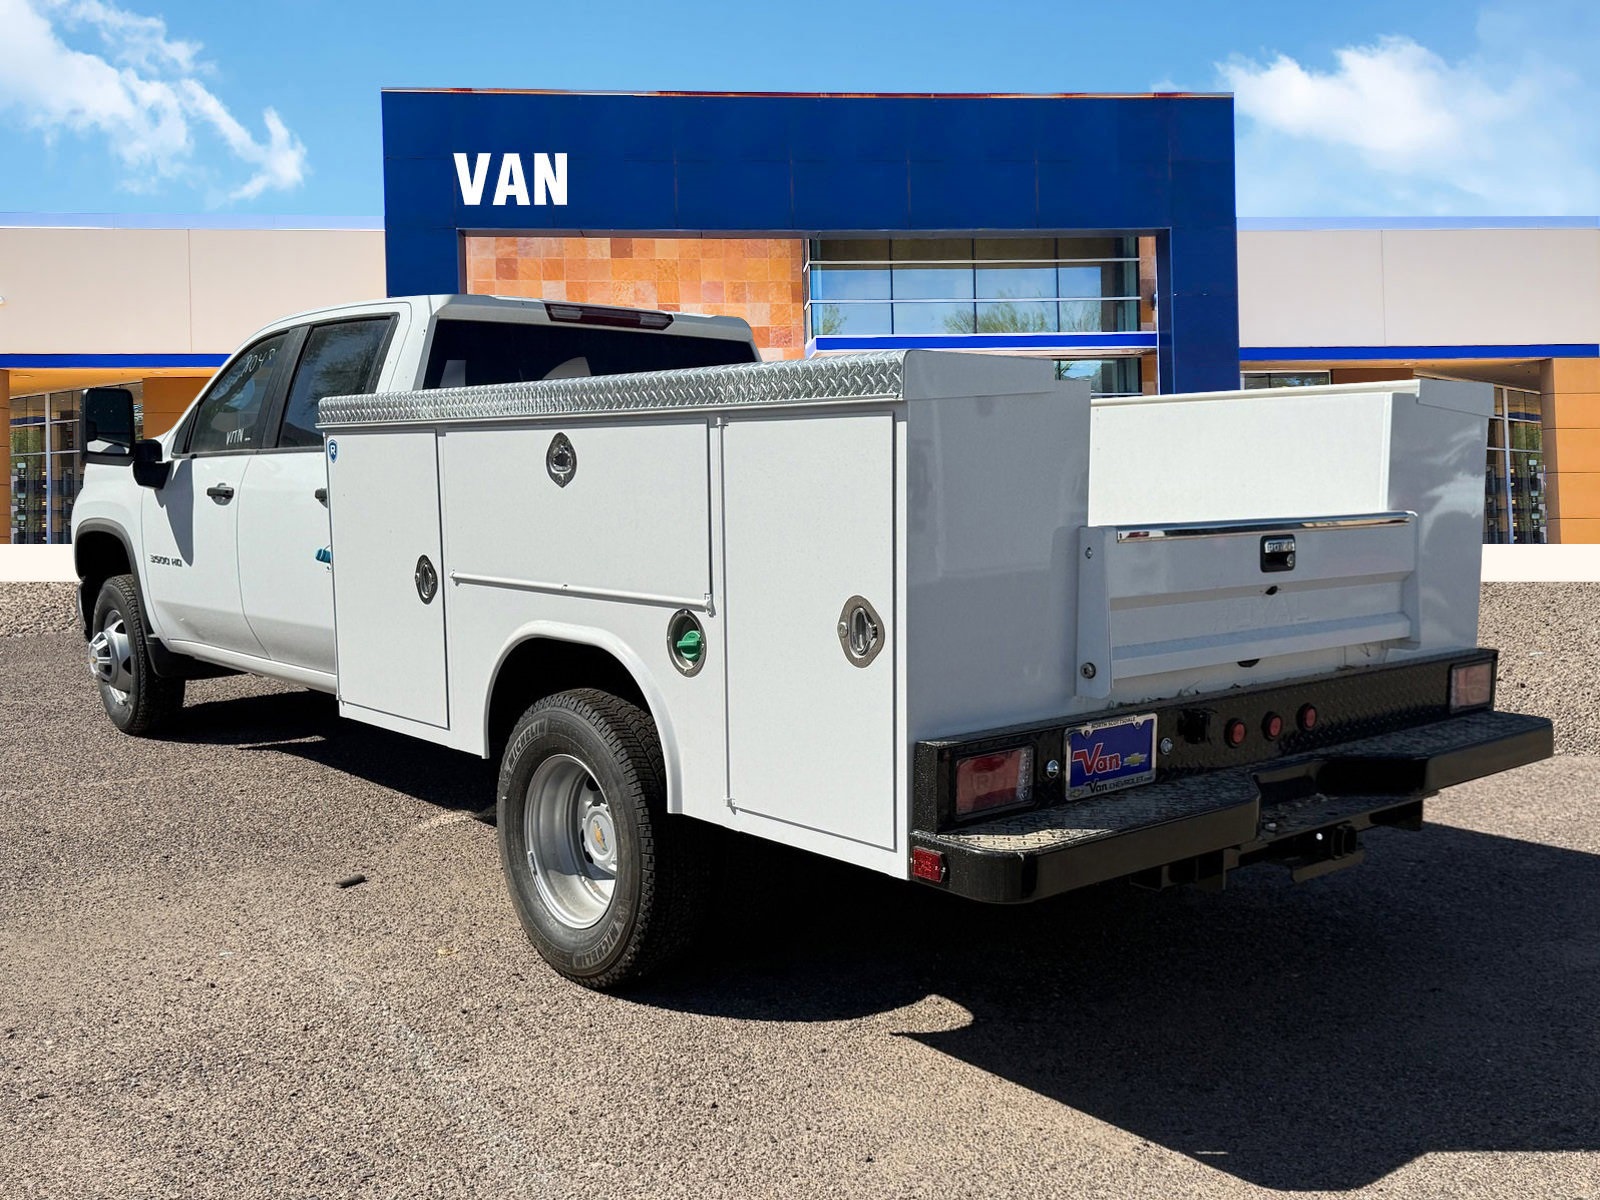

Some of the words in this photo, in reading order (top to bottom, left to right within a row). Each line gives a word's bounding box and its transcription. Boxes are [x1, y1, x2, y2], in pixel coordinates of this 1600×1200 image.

[453, 152, 568, 206] VAN
[150, 554, 170, 566] 3500
[171, 557, 183, 567] HD
[1072, 742, 1122, 776] Van
[1084, 778, 1108, 793] Van
